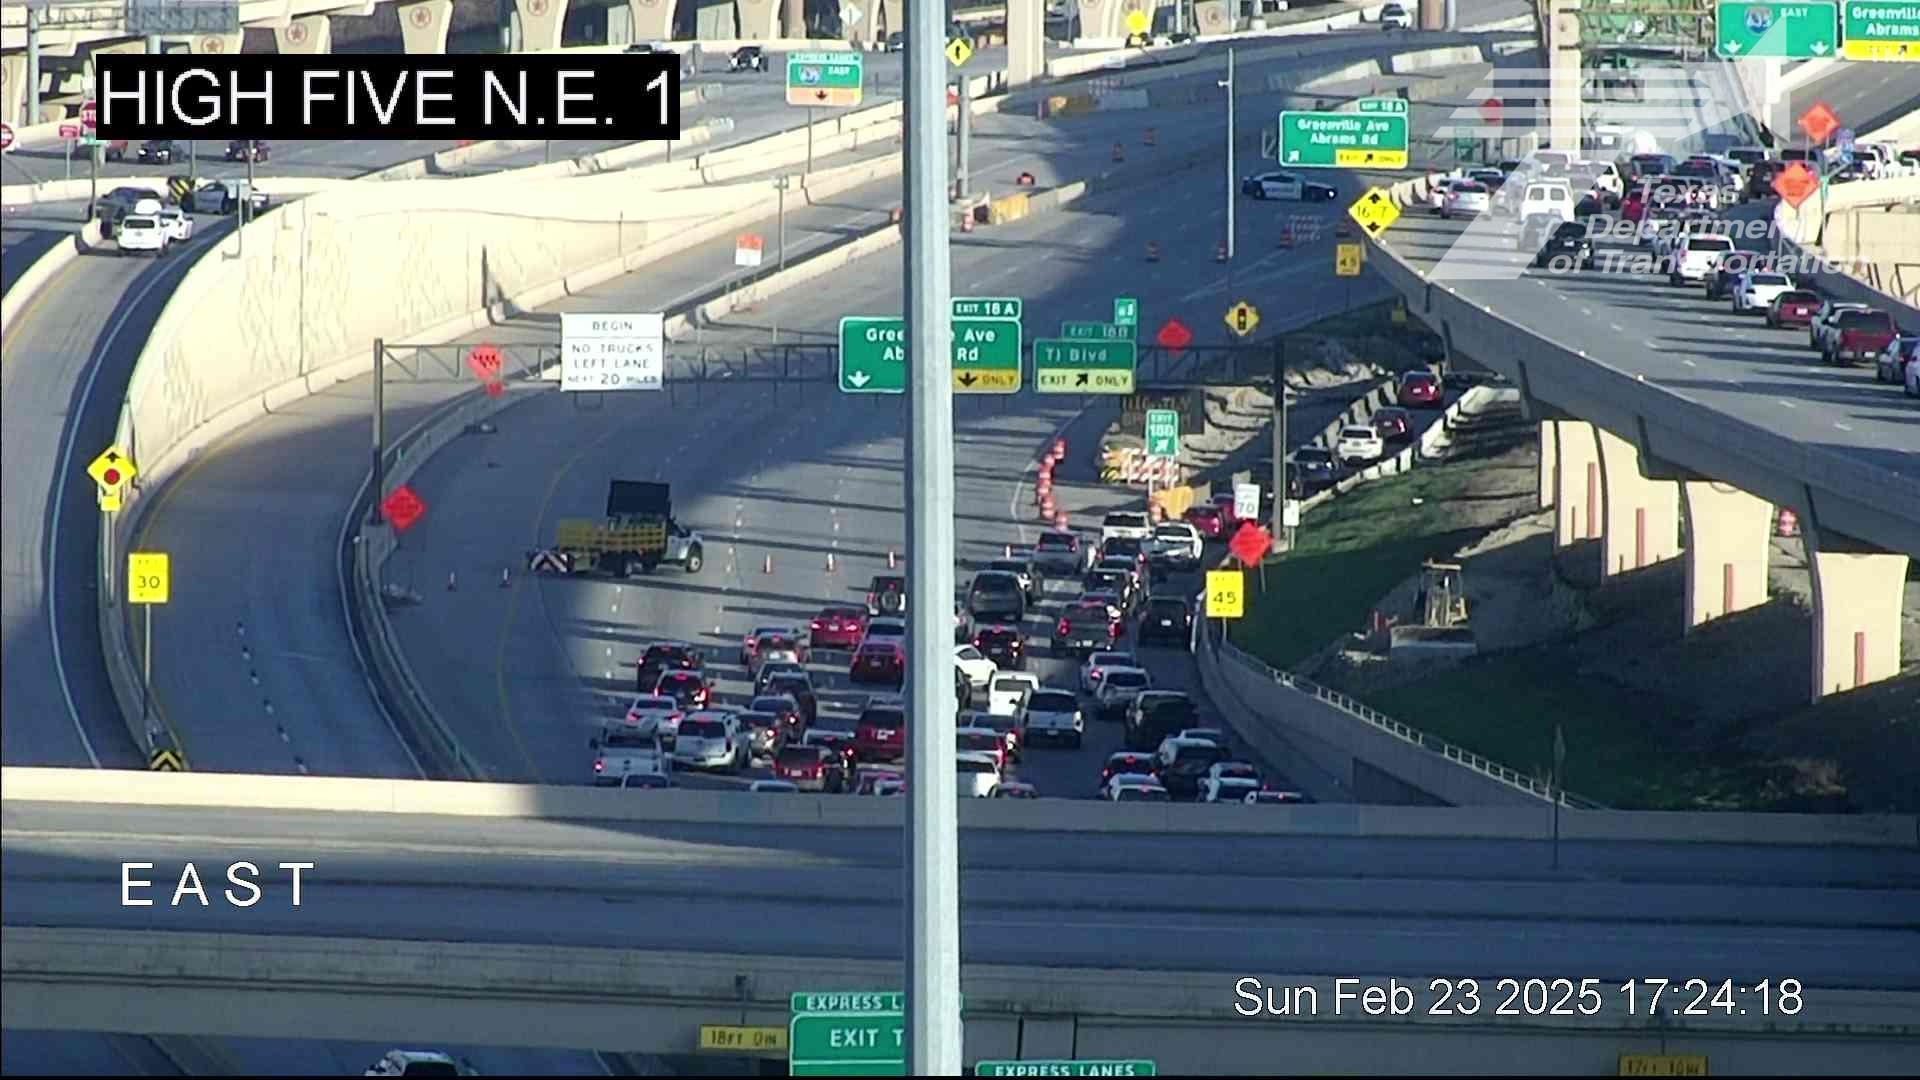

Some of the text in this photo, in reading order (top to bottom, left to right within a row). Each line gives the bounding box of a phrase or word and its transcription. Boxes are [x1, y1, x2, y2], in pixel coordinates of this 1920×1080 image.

[1780, 7, 1808, 17] EAST
[1852, 6, 1920, 20] Greenvill
[1297, 118, 1390, 132] Greenville Ave
[1310, 132, 1379, 145] Abrams Rd
[955, 303, 980, 314] EXIT
[592, 320, 633, 331] BEGIN
[964, 327, 996, 343] Ave
[572, 343, 654, 354] NO TRUCKS
[957, 347, 979, 361] Rd
[1070, 347, 1107, 361] Blvd
[573, 358, 650, 369] LEFT LANE
[600, 373, 620, 386] 20
[982, 374, 1015, 386] ONLY
[1041, 374, 1128, 387] EXIT ONLY
[1238, 502, 1255, 514] 70
[137, 575, 161, 589] 30
[1212, 591, 1238, 605] 45
[806, 995, 882, 1011] EXPRESS
[830, 1029, 879, 1047] EXIT
[995, 1065, 1135, 1077] EXPRESS LANES
